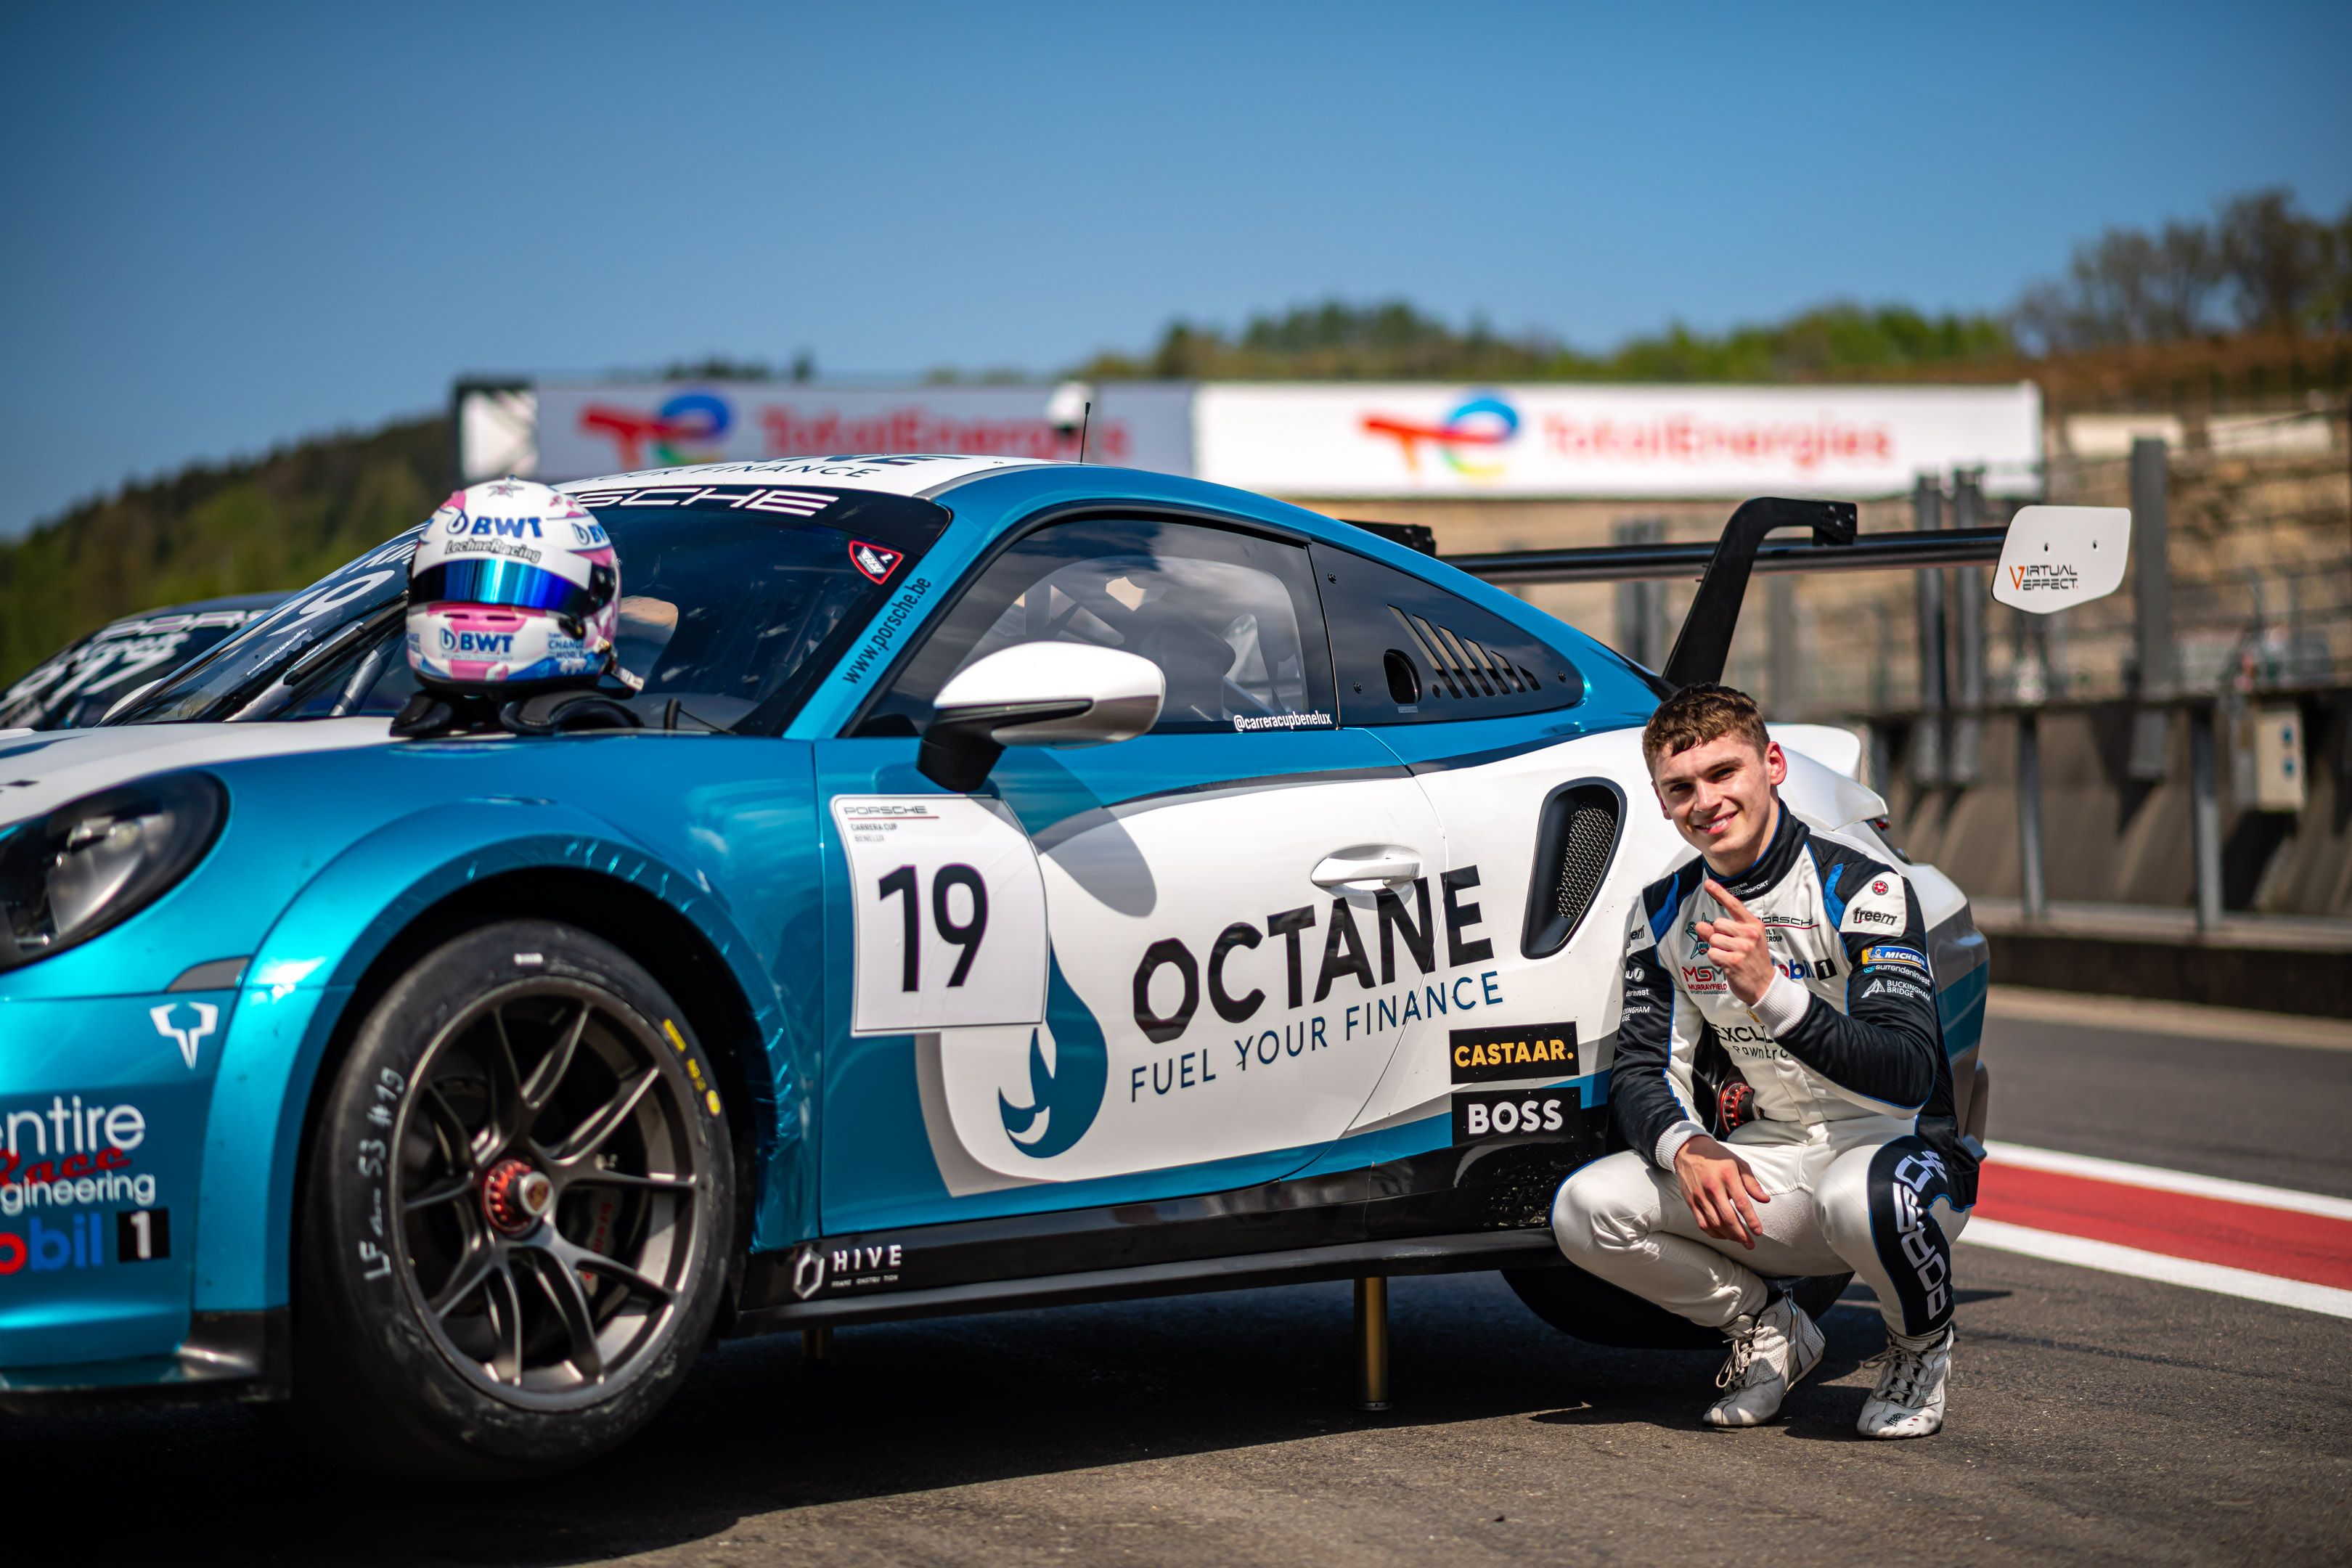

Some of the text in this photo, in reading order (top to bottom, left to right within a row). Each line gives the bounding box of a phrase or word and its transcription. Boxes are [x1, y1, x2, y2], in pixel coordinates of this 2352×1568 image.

[576, 486, 839, 517] SCHE
[471, 516, 543, 539] BWT
[2009, 564, 2078, 590] VIRTUAL
[460, 632, 514, 653] BWT
[843, 577, 931, 685] www.porsche.be
[1233, 710, 1333, 732] @carreracupbenelux
[844, 806, 928, 814] PORSCHE
[883, 822, 898, 831] CUP
[1731, 881, 1769, 897] OTORSPORT
[878, 862, 989, 993] 19
[1757, 916, 1813, 927] ORSCH
[1853, 907, 1897, 926] freem
[1133, 865, 1494, 1045] OCTANE
[1771, 958, 1830, 980] obil 1
[1876, 965, 1930, 986] surrendeninvest
[1887, 980, 1931, 1002] BUCKINGHAM
[1887, 986, 1914, 998] BRIDGE
[1130, 971, 1503, 1103] FUEL YOUR FINANCE
[1454, 1041, 1574, 1068] CASTAAR.
[0, 1095, 145, 1157] ntire
[1468, 1099, 1563, 1135] BOSS
[0, 1170, 155, 1217] gineering
[0, 1210, 152, 1276] obil 1
[1892, 1151, 1948, 1320] PORSCHE
[833, 1244, 902, 1273] HIVE
